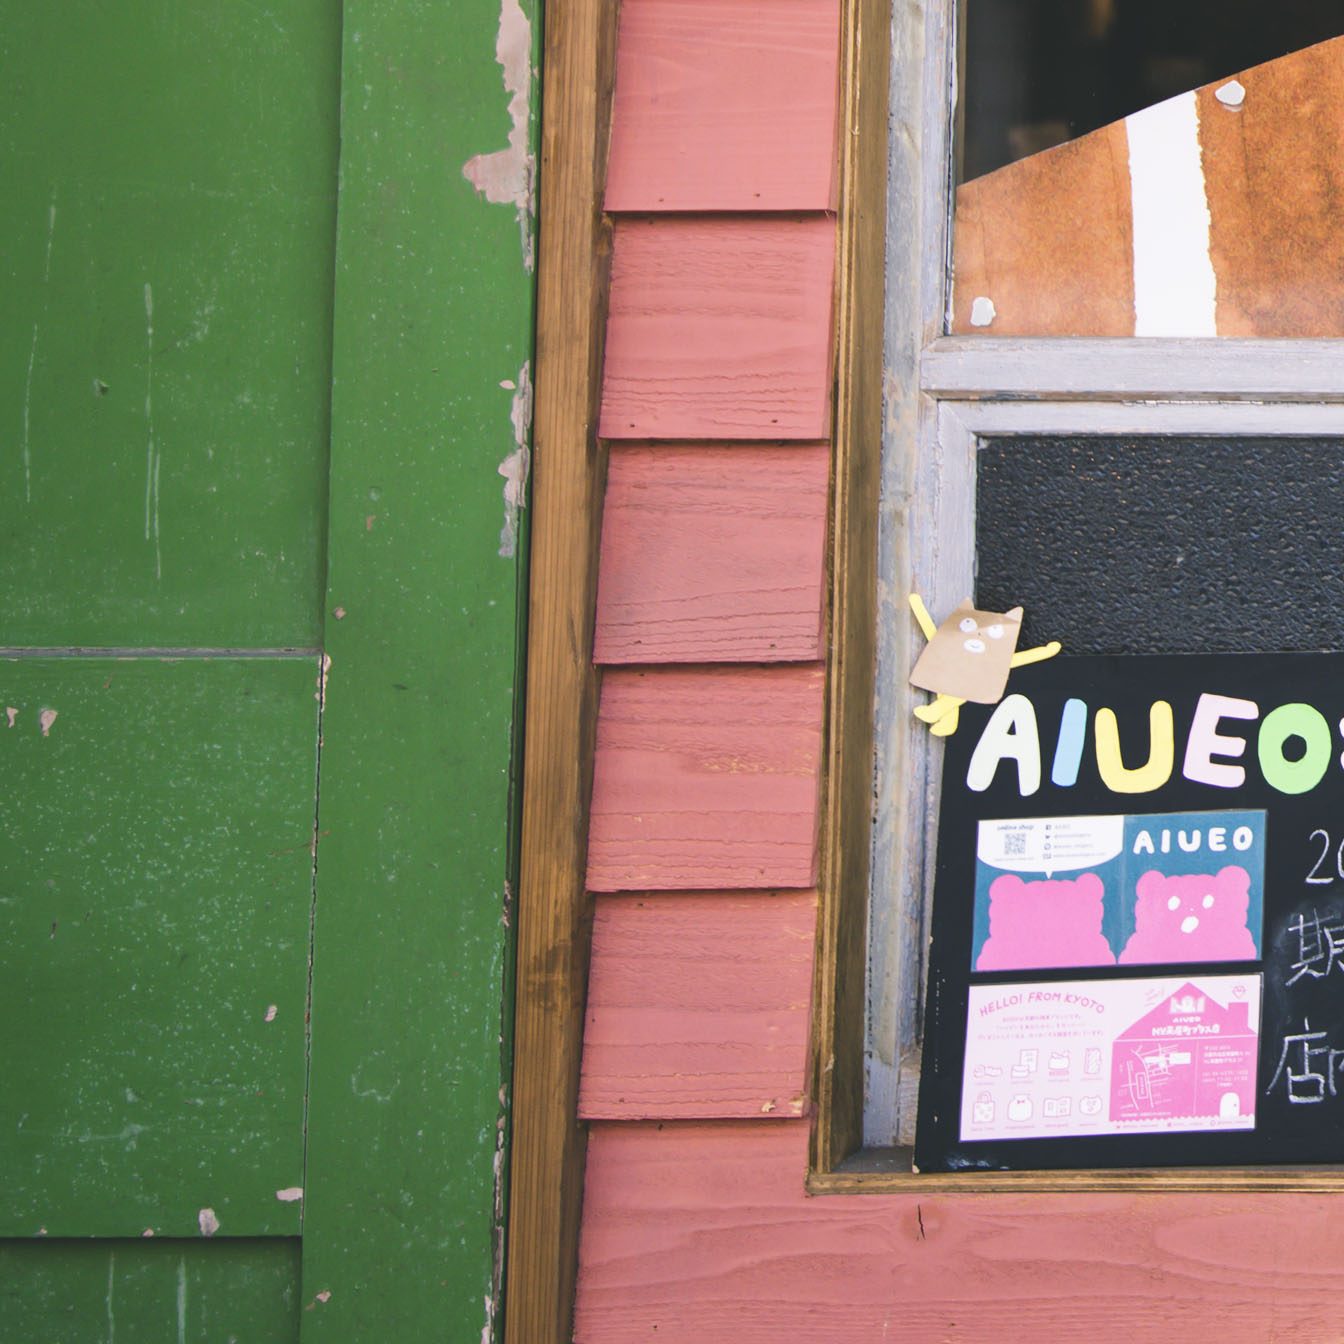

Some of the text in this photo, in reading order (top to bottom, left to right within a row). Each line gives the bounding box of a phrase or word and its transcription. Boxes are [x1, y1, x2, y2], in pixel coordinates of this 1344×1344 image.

[1133, 825, 1254, 855] AIUEO
[1027, 991, 1062, 1004] FROM
[1063, 993, 1106, 1014] KYOTO
